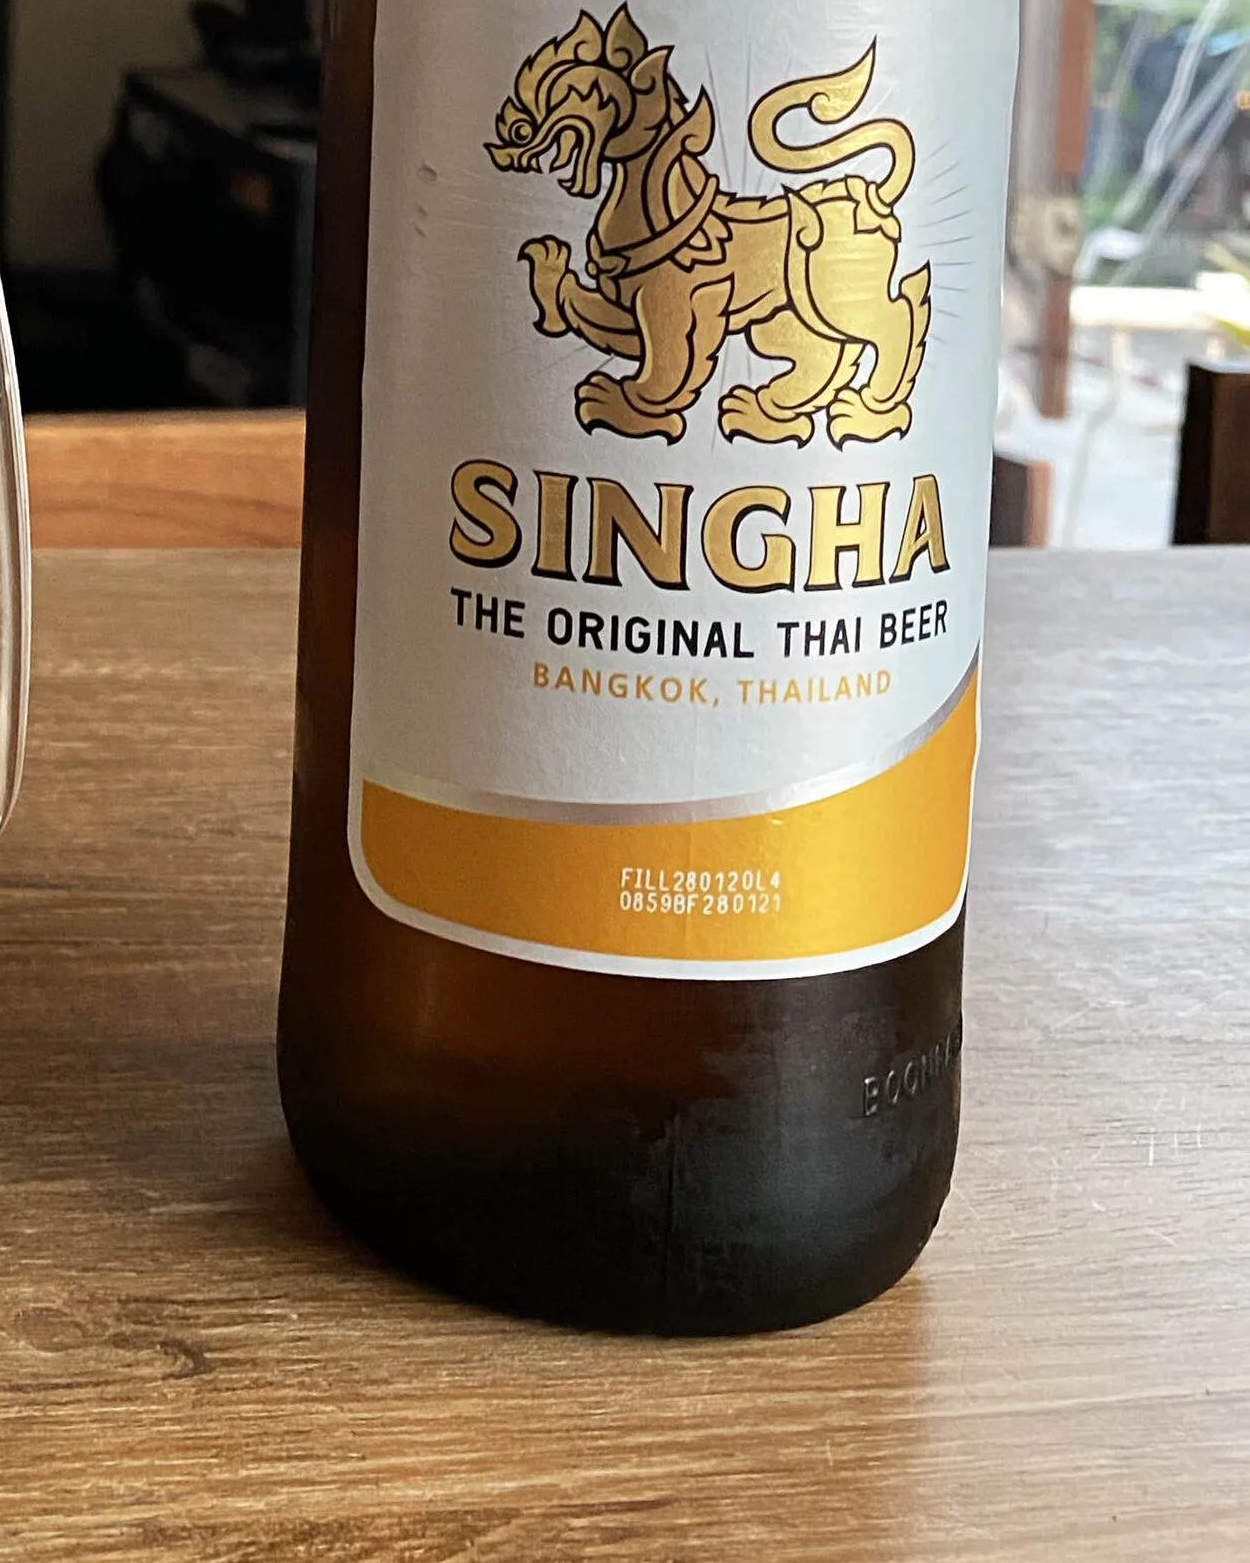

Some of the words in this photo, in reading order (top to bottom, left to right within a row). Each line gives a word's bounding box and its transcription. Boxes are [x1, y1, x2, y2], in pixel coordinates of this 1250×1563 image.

[449, 458, 952, 593] SINGHA
[451, 587, 526, 638] THE
[547, 606, 755, 659] ORIGINAL
[776, 615, 862, 659] THAI
[879, 599, 948, 650] BEER
[533, 661, 721, 708] BANGKOK,
[736, 669, 891, 705] THAILAND
